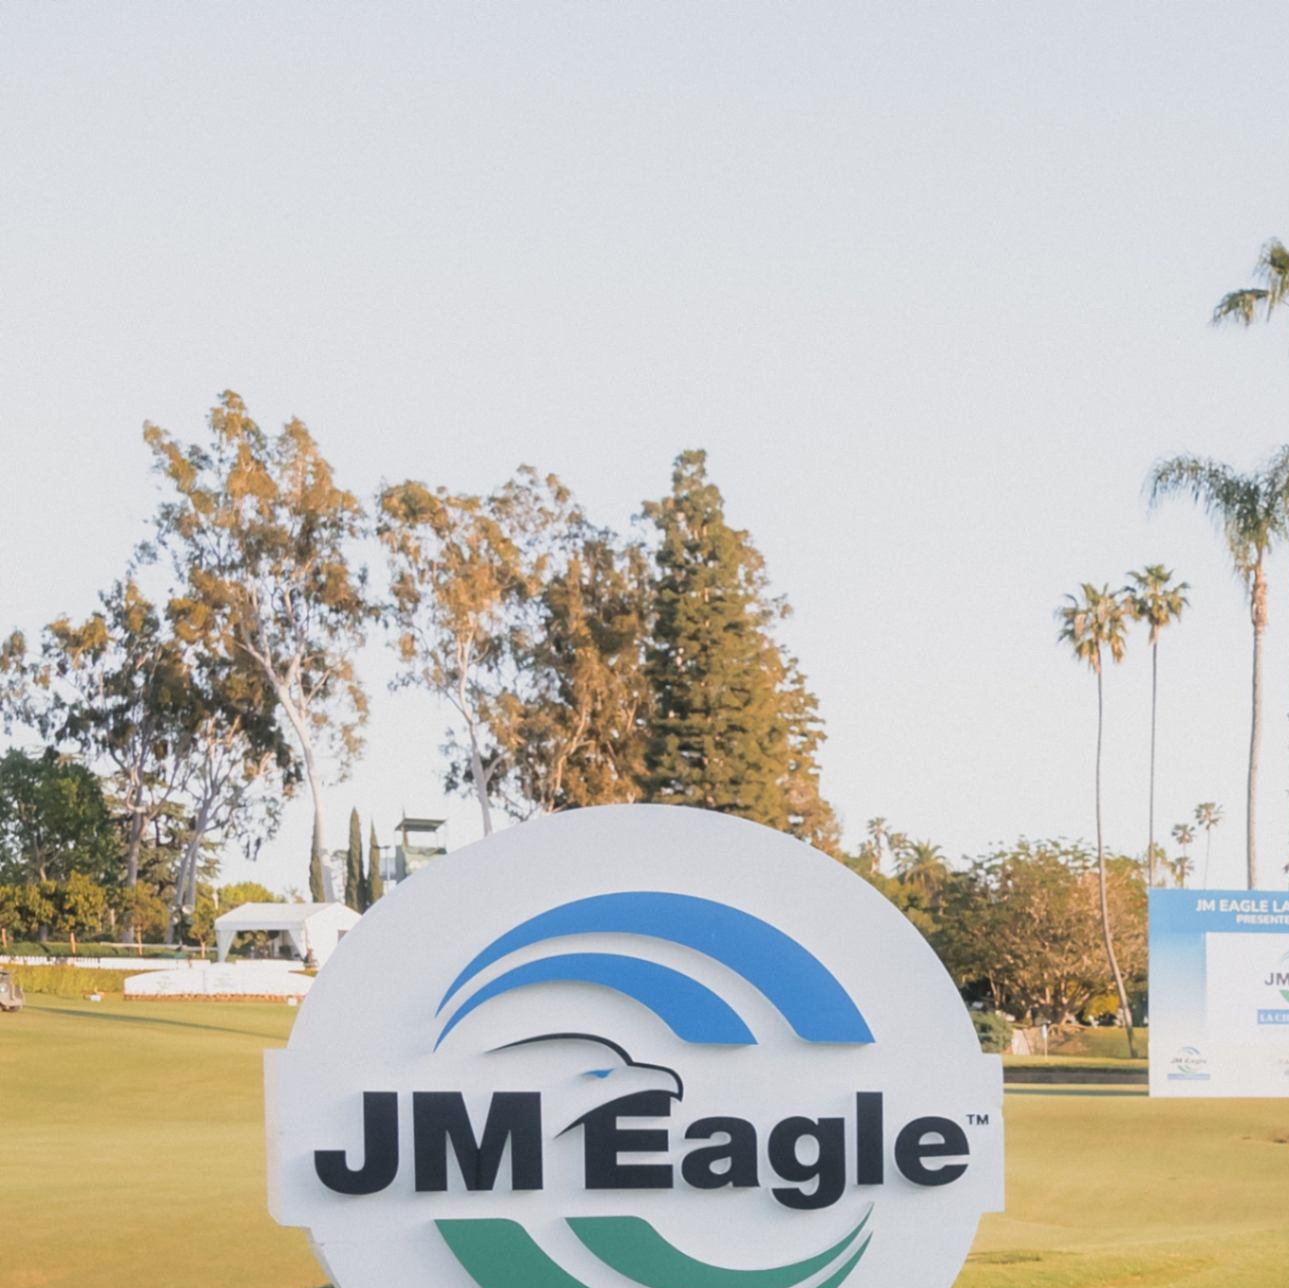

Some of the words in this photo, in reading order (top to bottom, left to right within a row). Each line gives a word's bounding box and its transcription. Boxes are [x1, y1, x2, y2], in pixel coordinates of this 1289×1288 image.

[1196, 899, 1216, 912] JM
[1220, 899, 1269, 913] EAGLE
[314, 1092, 543, 1196] JM
